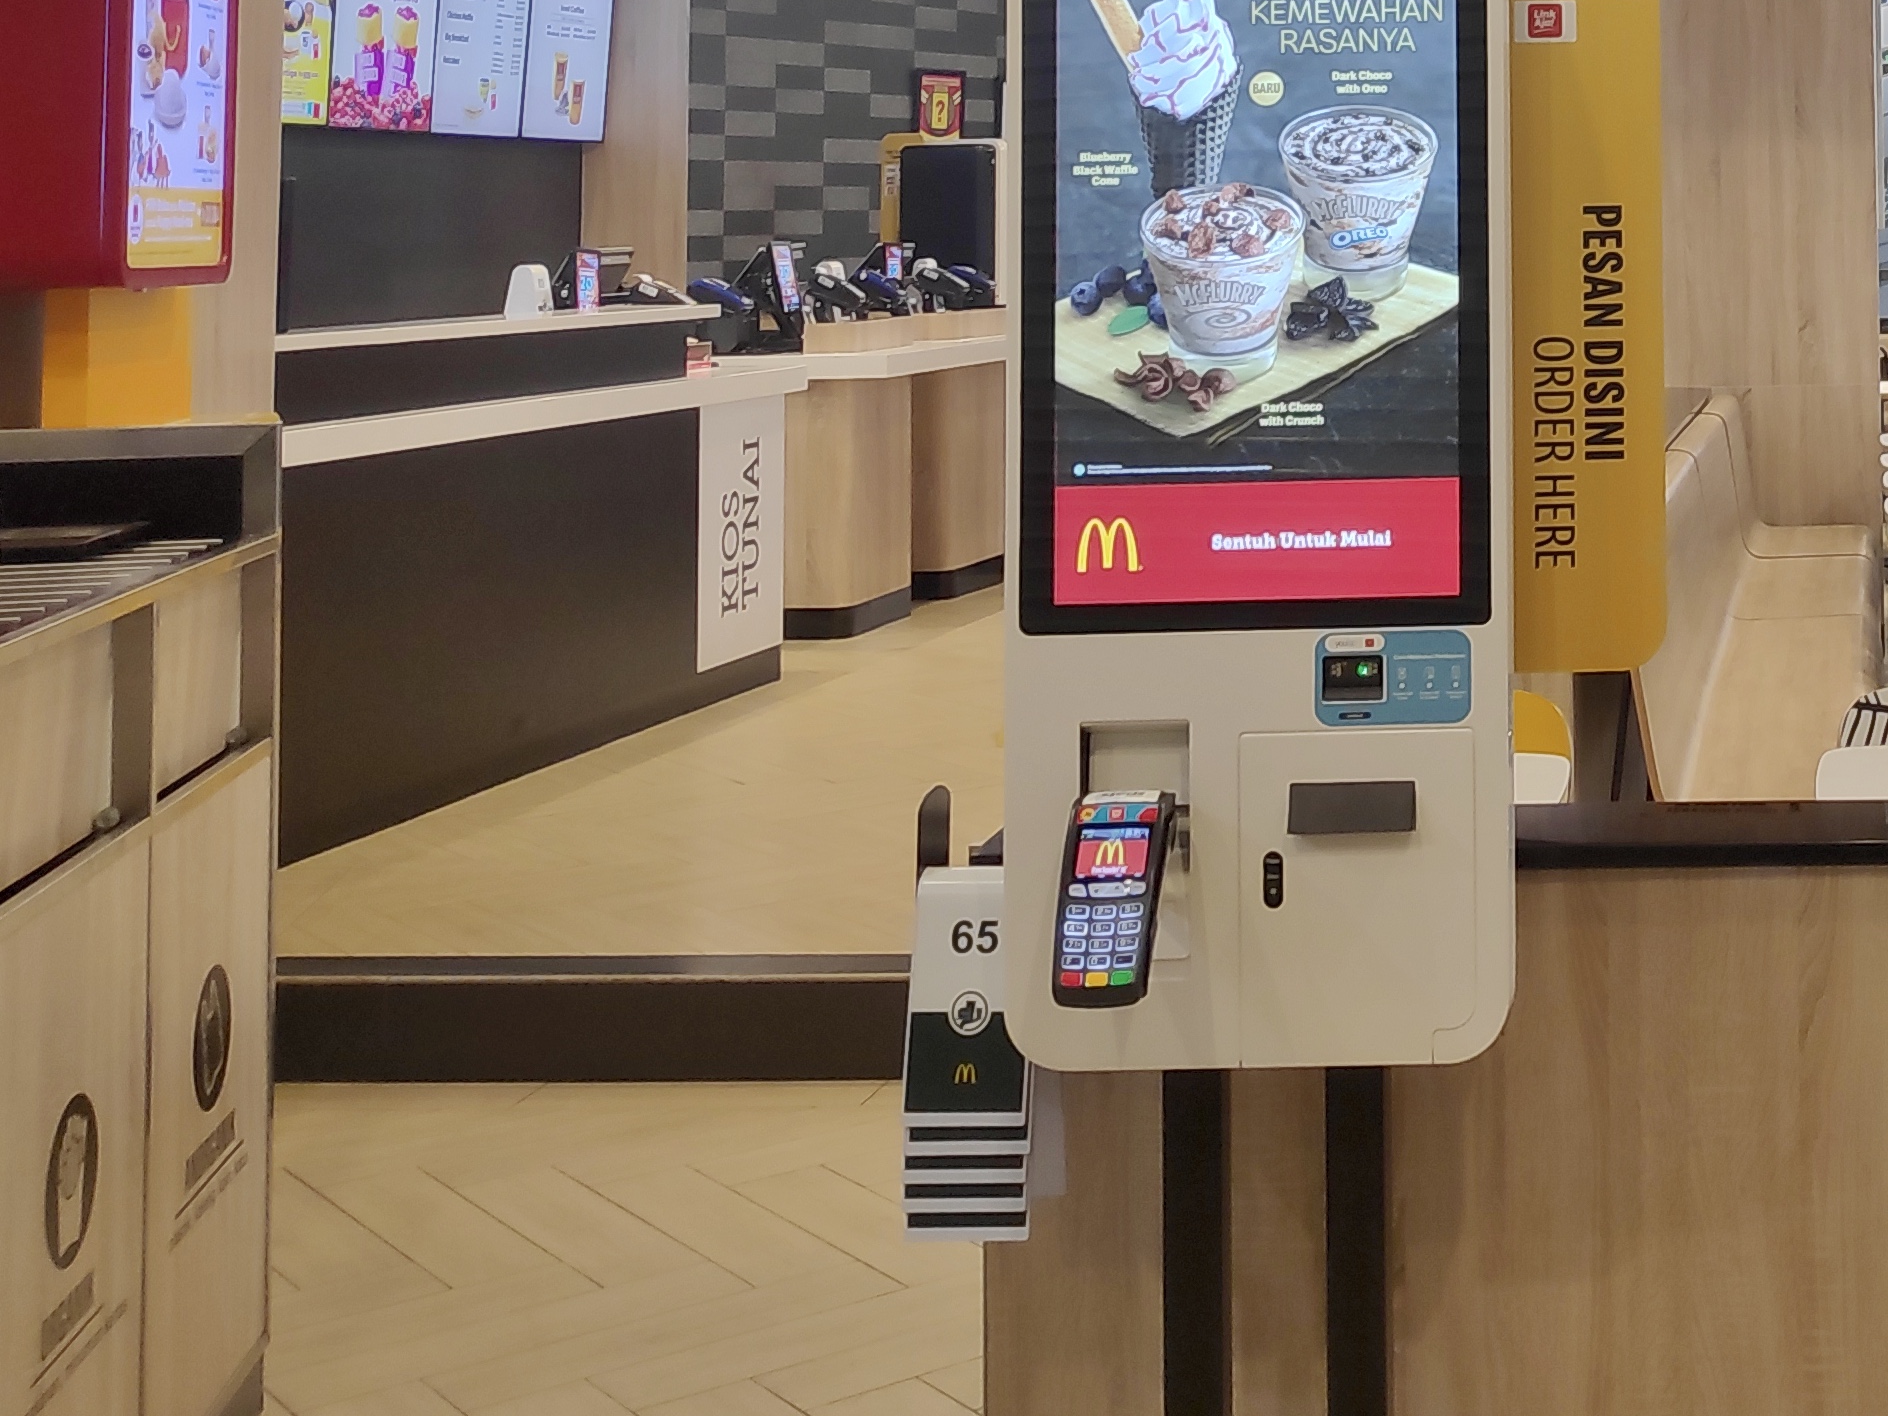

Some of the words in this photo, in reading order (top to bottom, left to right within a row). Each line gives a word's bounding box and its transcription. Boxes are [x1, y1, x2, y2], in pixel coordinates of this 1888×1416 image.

[1279, 28, 1416, 54] RASANYA
[1252, 82, 1281, 95] BARU
[1331, 71, 1357, 81] Dark
[1359, 70, 1392, 81] Choco
[1336, 84, 1360, 94] with
[1333, 227, 1388, 247] OREO
[1582, 204, 1624, 328] PESAN
[1261, 402, 1287, 413] Dark
[1288, 401, 1323, 412] Choco
[1533, 335, 1575, 463] ORDER
[1583, 340, 1625, 461] DISINI
[1259, 416, 1284, 426] with
[1285, 415, 1325, 426] Crunch
[741, 435, 761, 611] TUNAI
[1534, 474, 1576, 570] HERE
[1211, 532, 1277, 551] Sentuh
[1279, 530, 1337, 549] Untuk
[1340, 529, 1392, 548] Mulai
[720, 489, 740, 619] KIOS
[950, 919, 999, 954] 65
